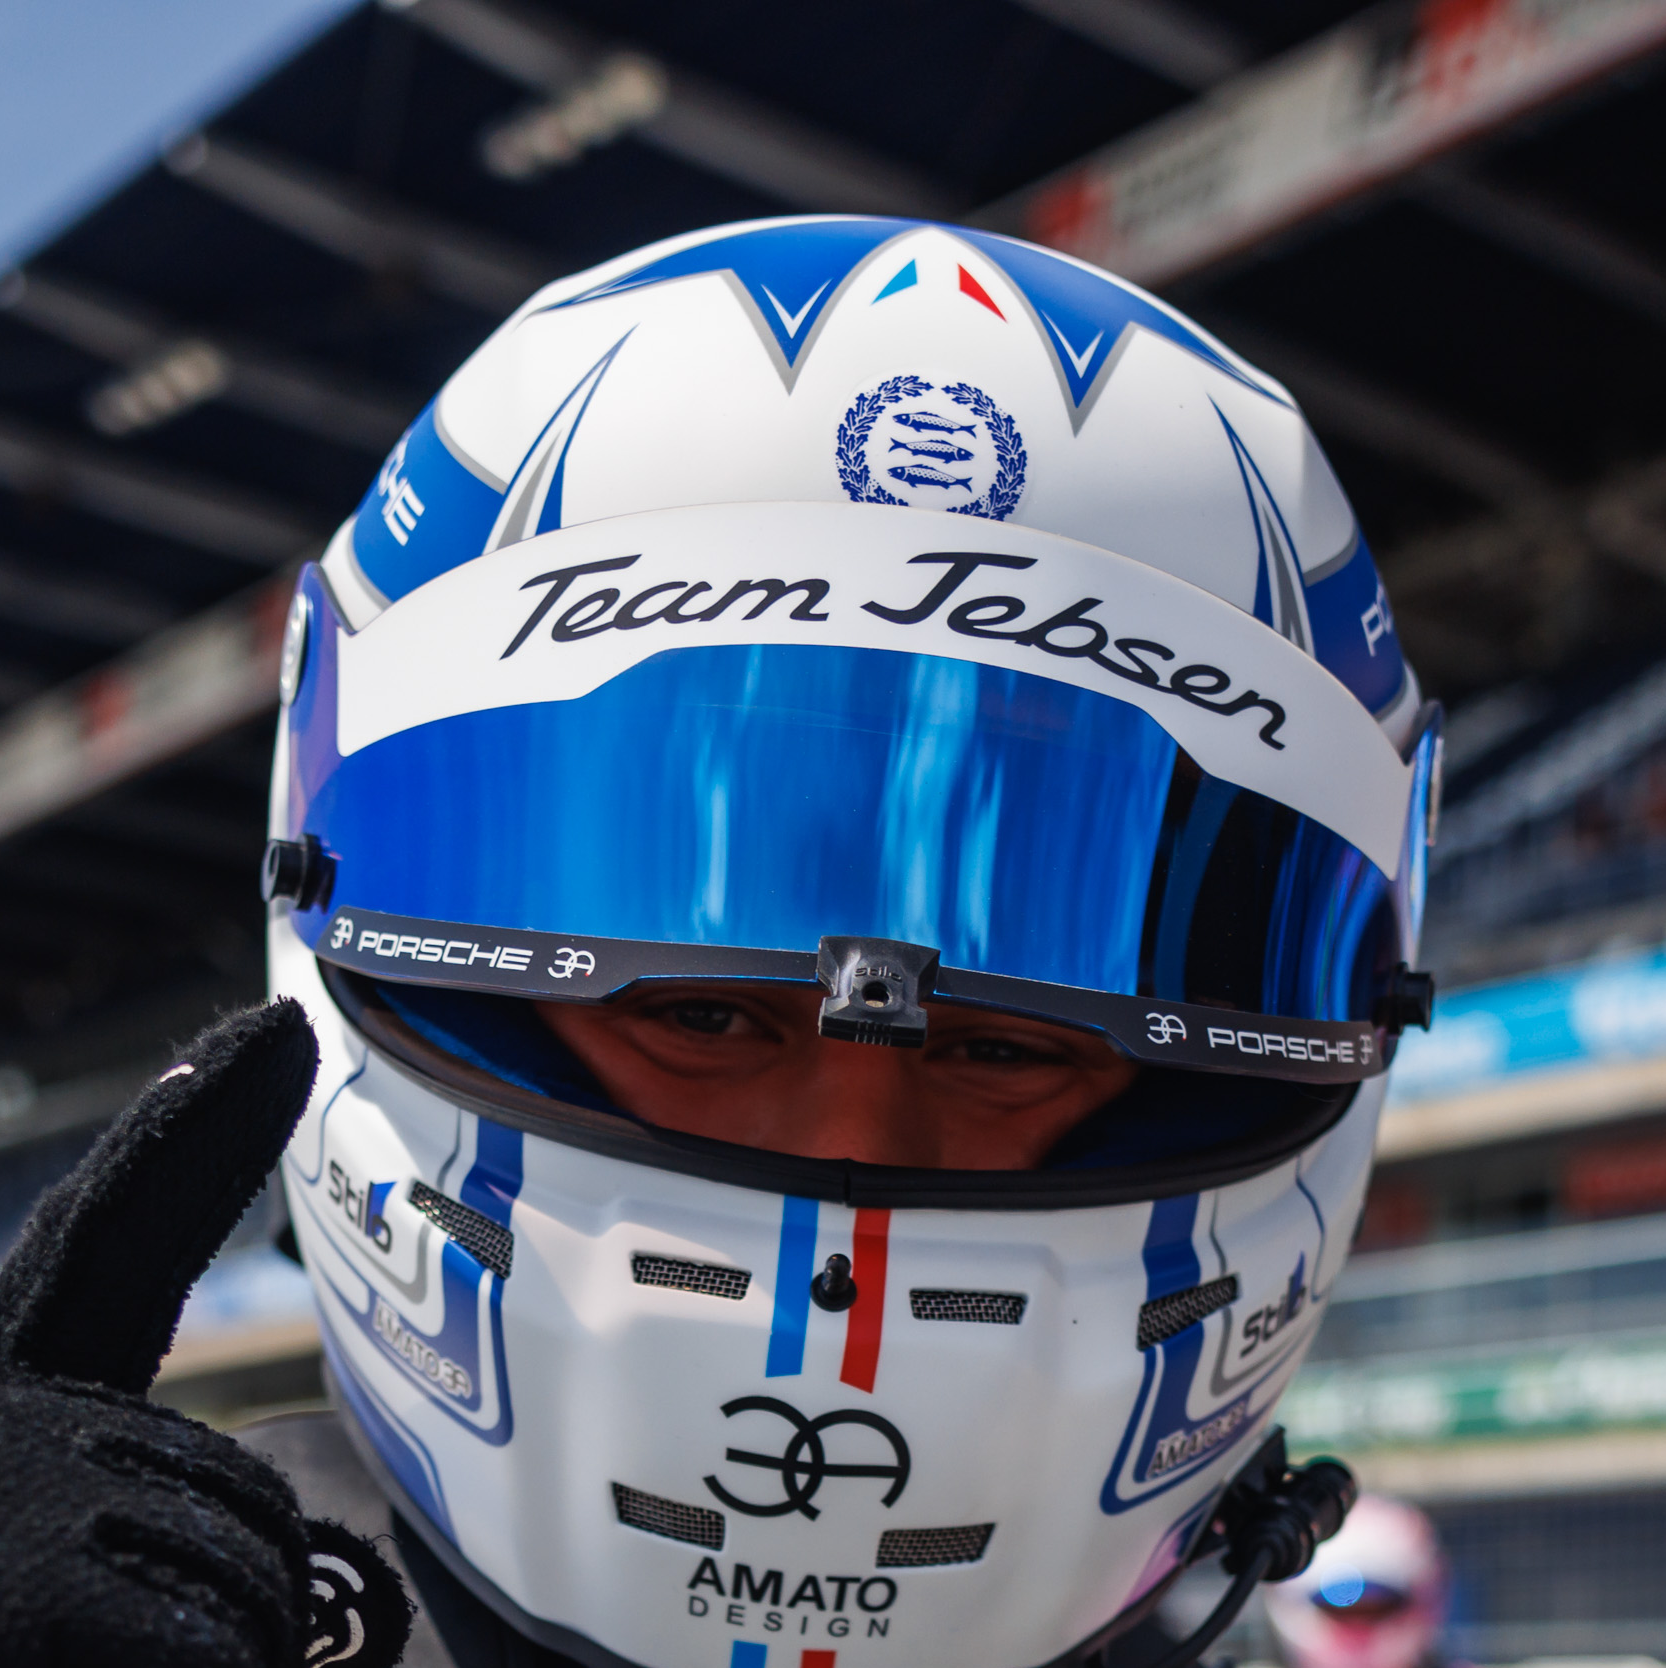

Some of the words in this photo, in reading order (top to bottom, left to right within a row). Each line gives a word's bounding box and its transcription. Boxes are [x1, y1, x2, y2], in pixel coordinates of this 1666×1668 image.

[500, 554, 829, 660] Team
[860, 552, 1288, 752] Jebsen
[357, 930, 533, 971] PORSCHE
[1207, 1027, 1355, 1063] PORSCHE
[329, 1160, 394, 1254] Stilo
[687, 1556, 898, 1613] AMATO
[688, 1595, 890, 1638] DESIGN
